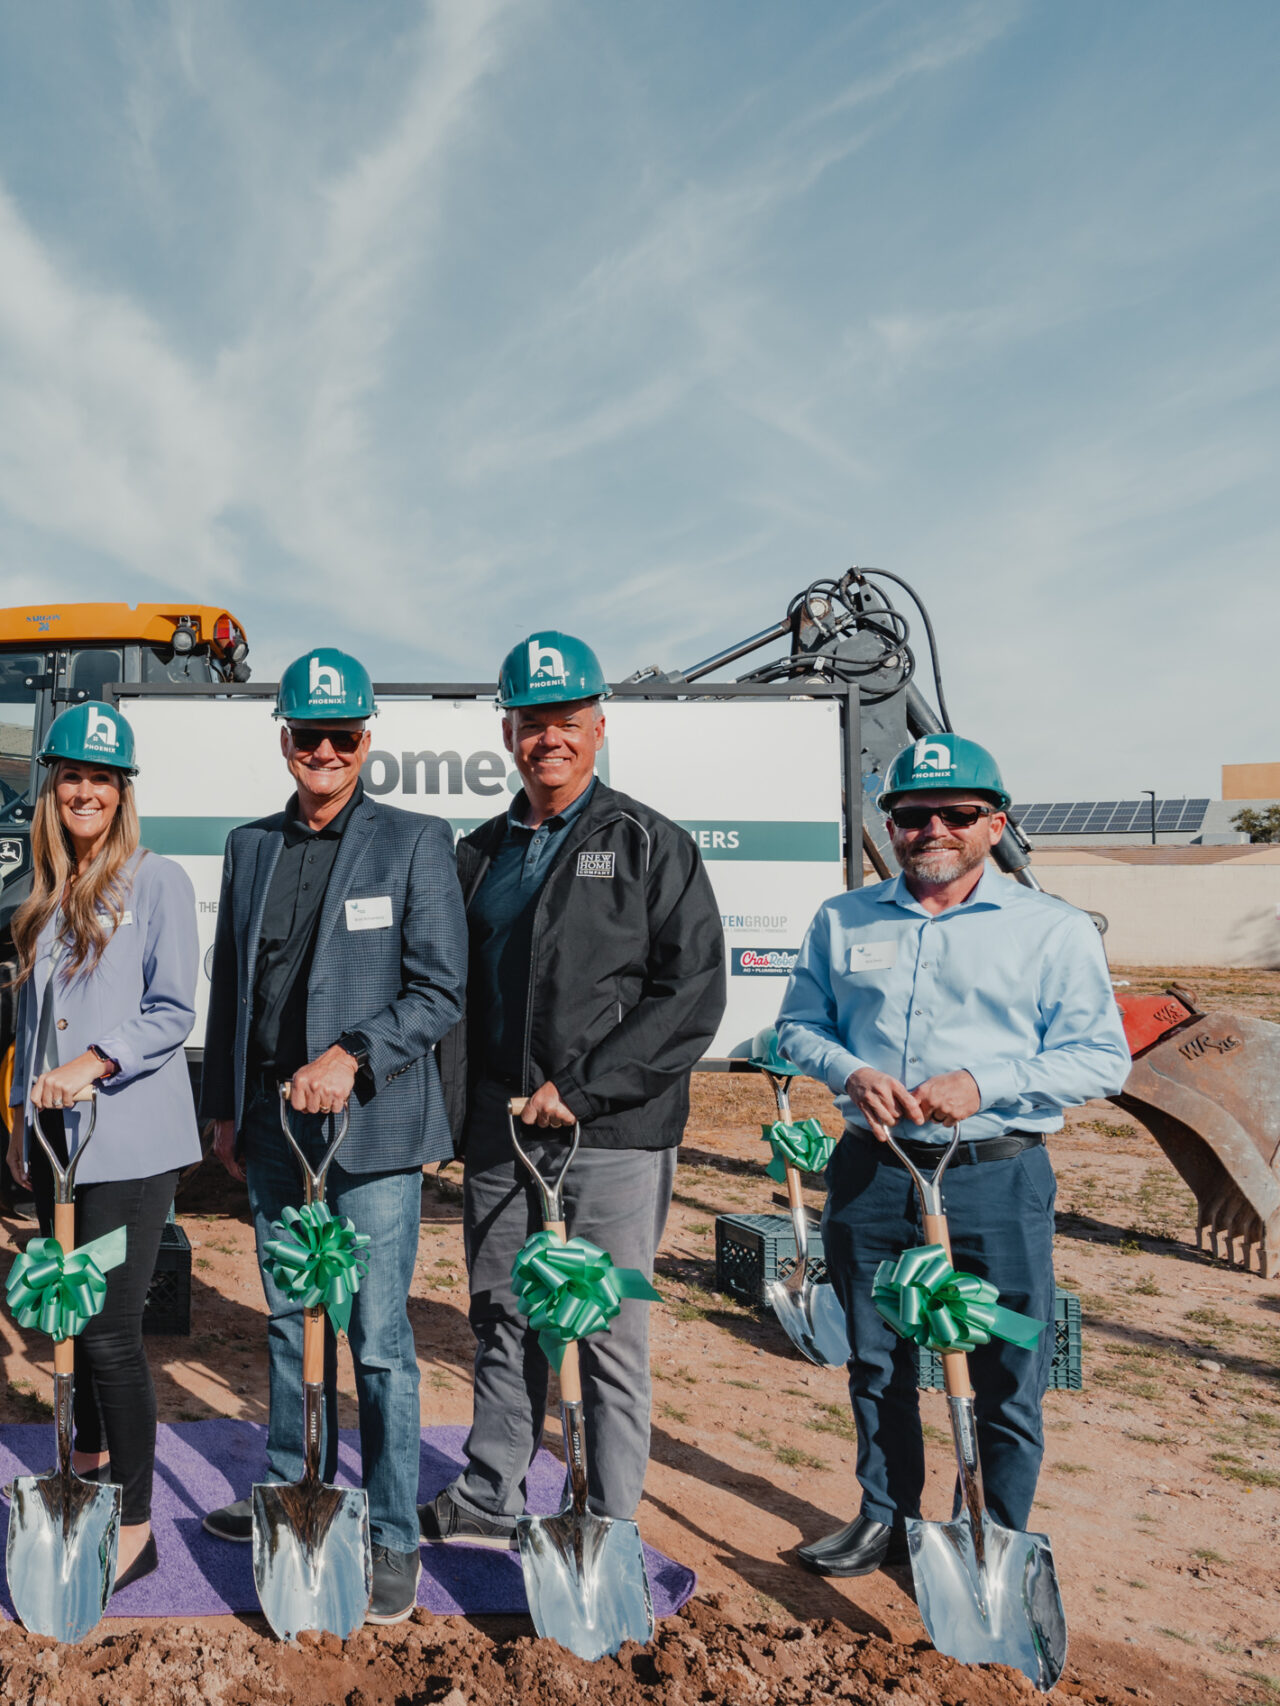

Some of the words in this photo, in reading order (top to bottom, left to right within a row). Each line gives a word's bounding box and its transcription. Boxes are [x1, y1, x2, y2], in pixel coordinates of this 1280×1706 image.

[529, 680, 565, 688] PHOENIX
[84, 743, 116, 753] PHOENIX
[362, 750, 508, 796] ome
[911, 771, 952, 780] PHOENIX
[580, 860, 611, 870] HOME
[199, 901, 218, 913] THE
